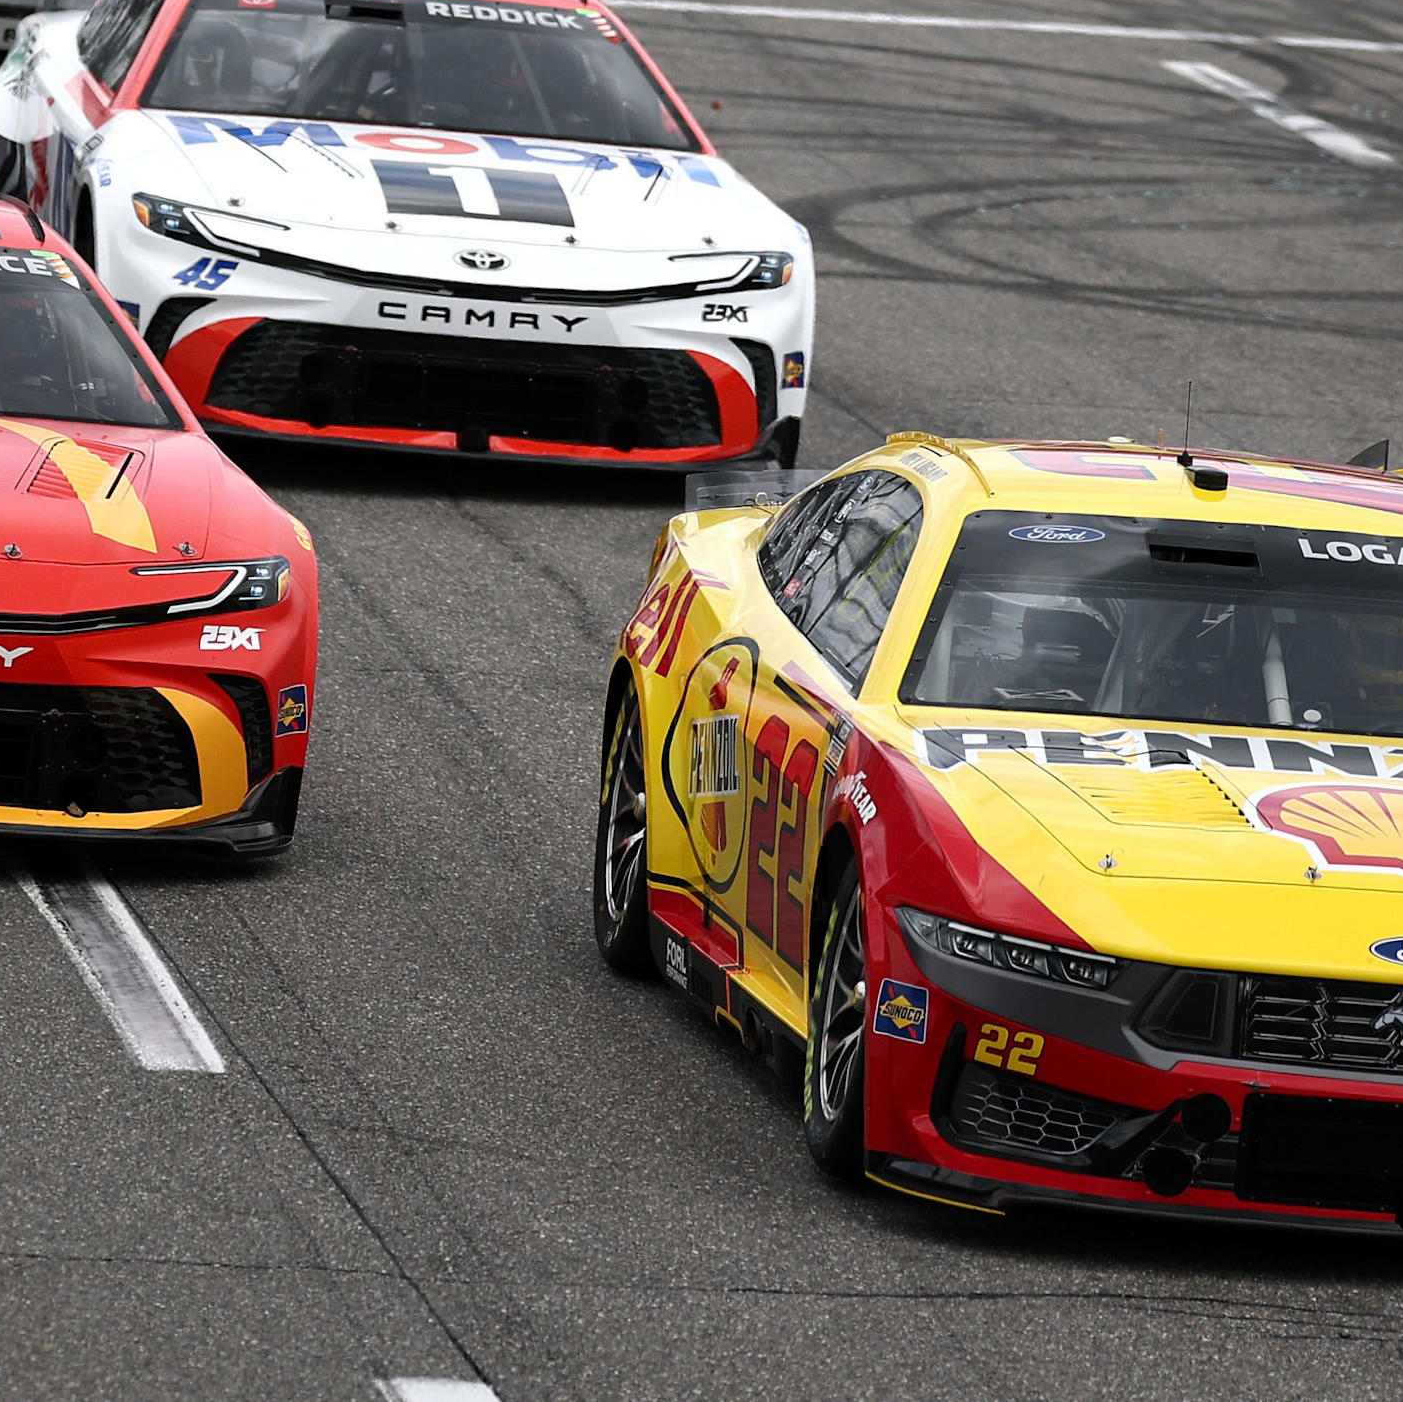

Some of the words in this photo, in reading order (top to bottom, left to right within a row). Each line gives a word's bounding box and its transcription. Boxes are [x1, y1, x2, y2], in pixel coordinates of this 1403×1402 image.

[424, 0, 585, 31] REDDICK
[167, 114, 724, 189] Mobil
[424, 165, 502, 217] 1
[172, 256, 240, 291] 45
[377, 301, 591, 334] CAMRY
[745, 713, 820, 978] 22
[880, 1001, 925, 1026] SUNOCO
[973, 1022, 1046, 1077] 22
